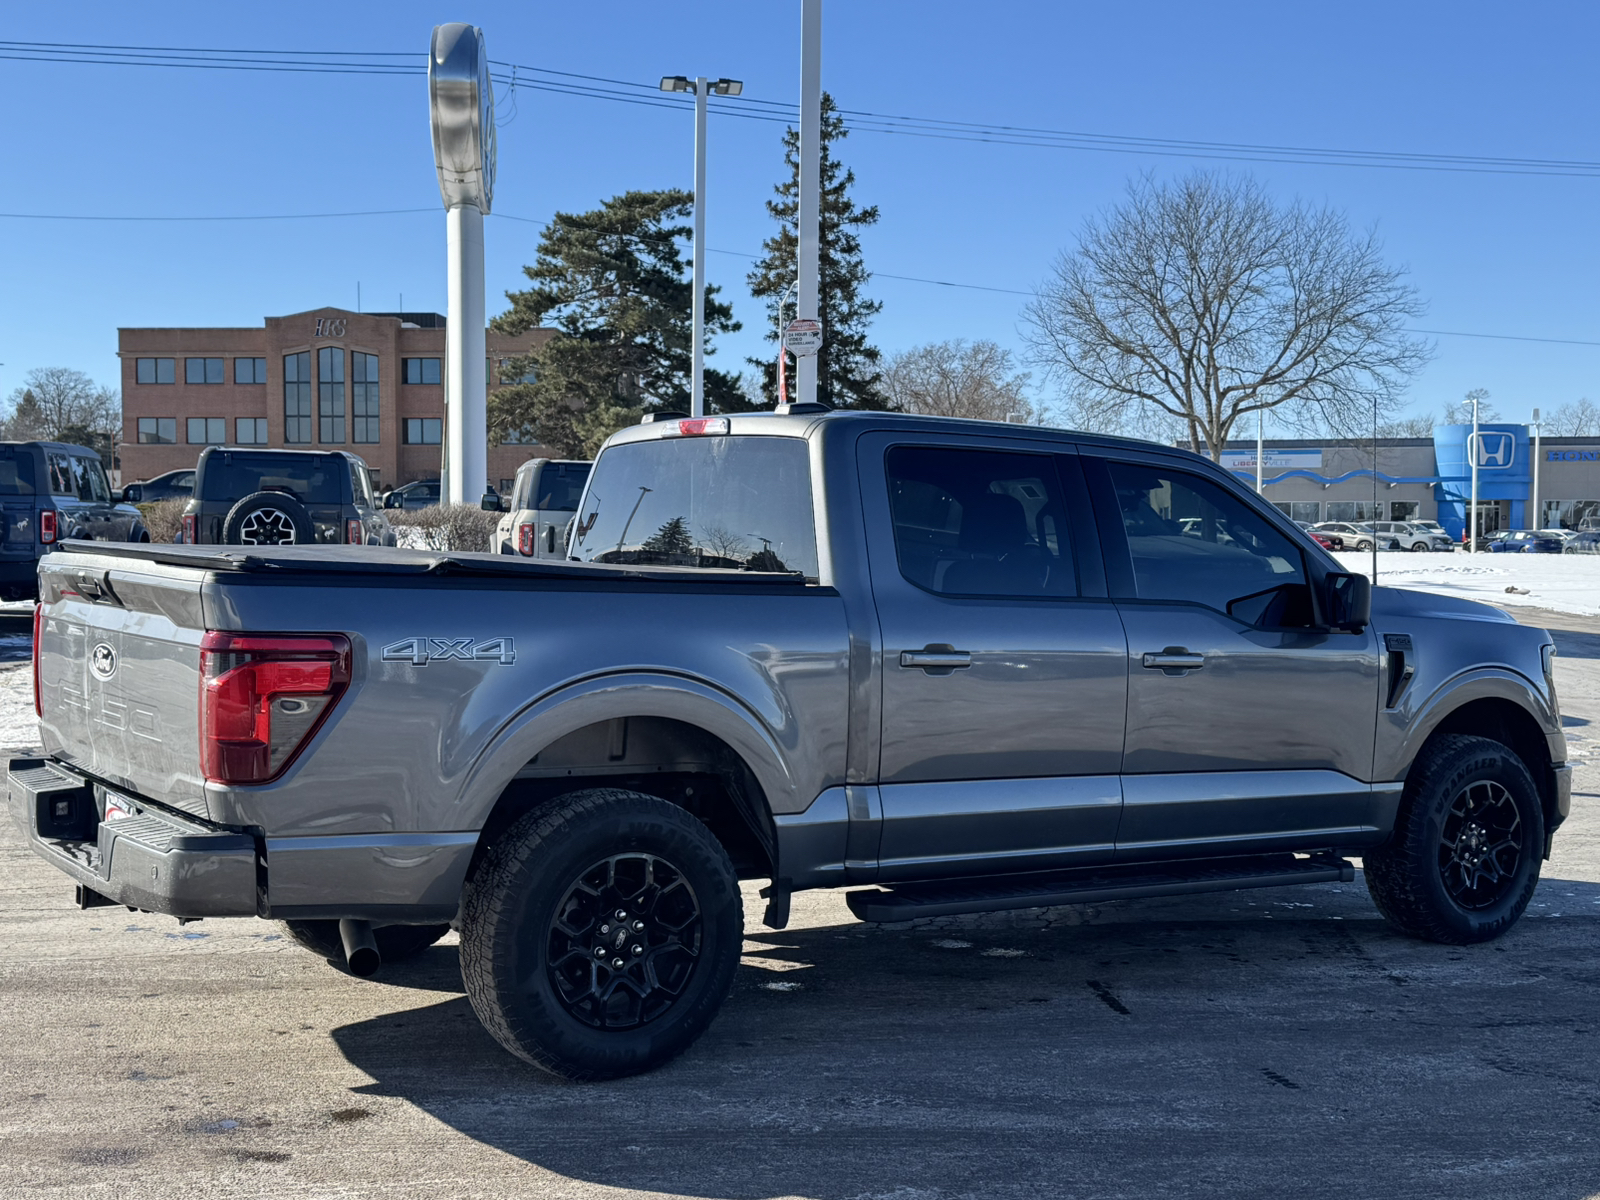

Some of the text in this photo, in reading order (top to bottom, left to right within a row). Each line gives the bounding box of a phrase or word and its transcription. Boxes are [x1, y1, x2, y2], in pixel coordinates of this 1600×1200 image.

[1547, 451, 1600, 463] HON
[95, 646, 112, 672] Ford
[1434, 757, 1497, 815] WRANGLER
